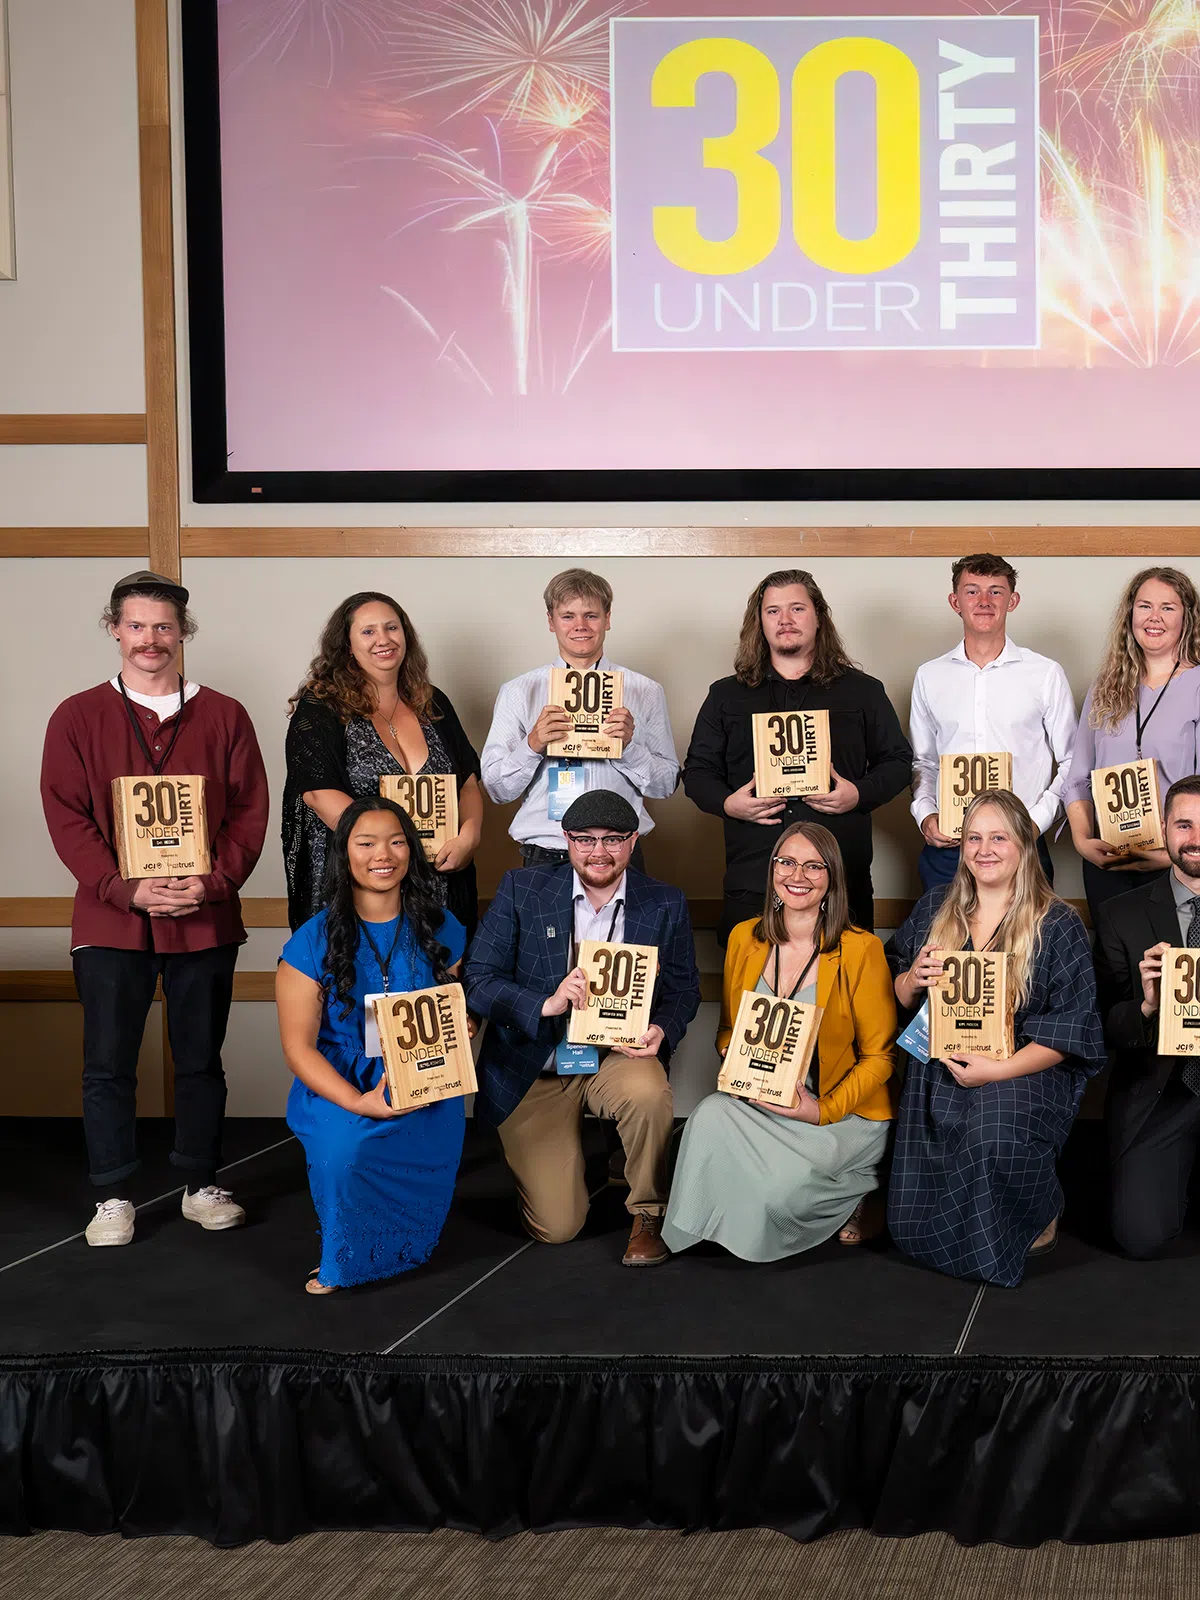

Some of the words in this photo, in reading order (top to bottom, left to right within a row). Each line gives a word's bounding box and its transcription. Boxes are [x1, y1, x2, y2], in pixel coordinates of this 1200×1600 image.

[651, 37, 921, 275] 30
[938, 38, 1017, 330] THIRTY
[653, 282, 922, 333] UNDER
[565, 671, 600, 713] 30
[602, 672, 613, 724] THIRTY
[565, 714, 599, 723] NDER
[768, 714, 804, 756] 30
[804, 714, 817, 764] THIRTY
[770, 755, 805, 767] UNDER
[953, 756, 986, 796] 30
[989, 756, 998, 790] IRTY
[133, 781, 177, 827] 30
[177, 781, 193, 836] THIRTY
[398, 776, 433, 819] 30
[435, 777, 446, 828] THIRTY
[1105, 768, 1139, 813] 30
[1137, 766, 1152, 816] THIRTY
[137, 827, 179, 838] UNDER
[414, 820, 434, 829] DER
[1109, 809, 1141, 824] UNDER
[590, 949, 633, 997] 30
[630, 952, 648, 1010] THIRTY
[942, 957, 981, 1005] 30
[983, 958, 995, 1016] THIRTY
[392, 995, 440, 1050] 30
[436, 993, 457, 1054] THIRTY
[588, 997, 628, 1009] UNDER
[744, 998, 790, 1050] 30
[941, 1006, 980, 1017] UNDER
[399, 1045, 443, 1063] UNDER
[740, 1045, 779, 1062] UNDER
[780, 1006, 804, 1063] THIRTY
[410, 1088, 423, 1097] JCI
[446, 1080, 461, 1089] trust
[731, 1080, 745, 1088] JCI
[767, 1088, 782, 1097] trust
